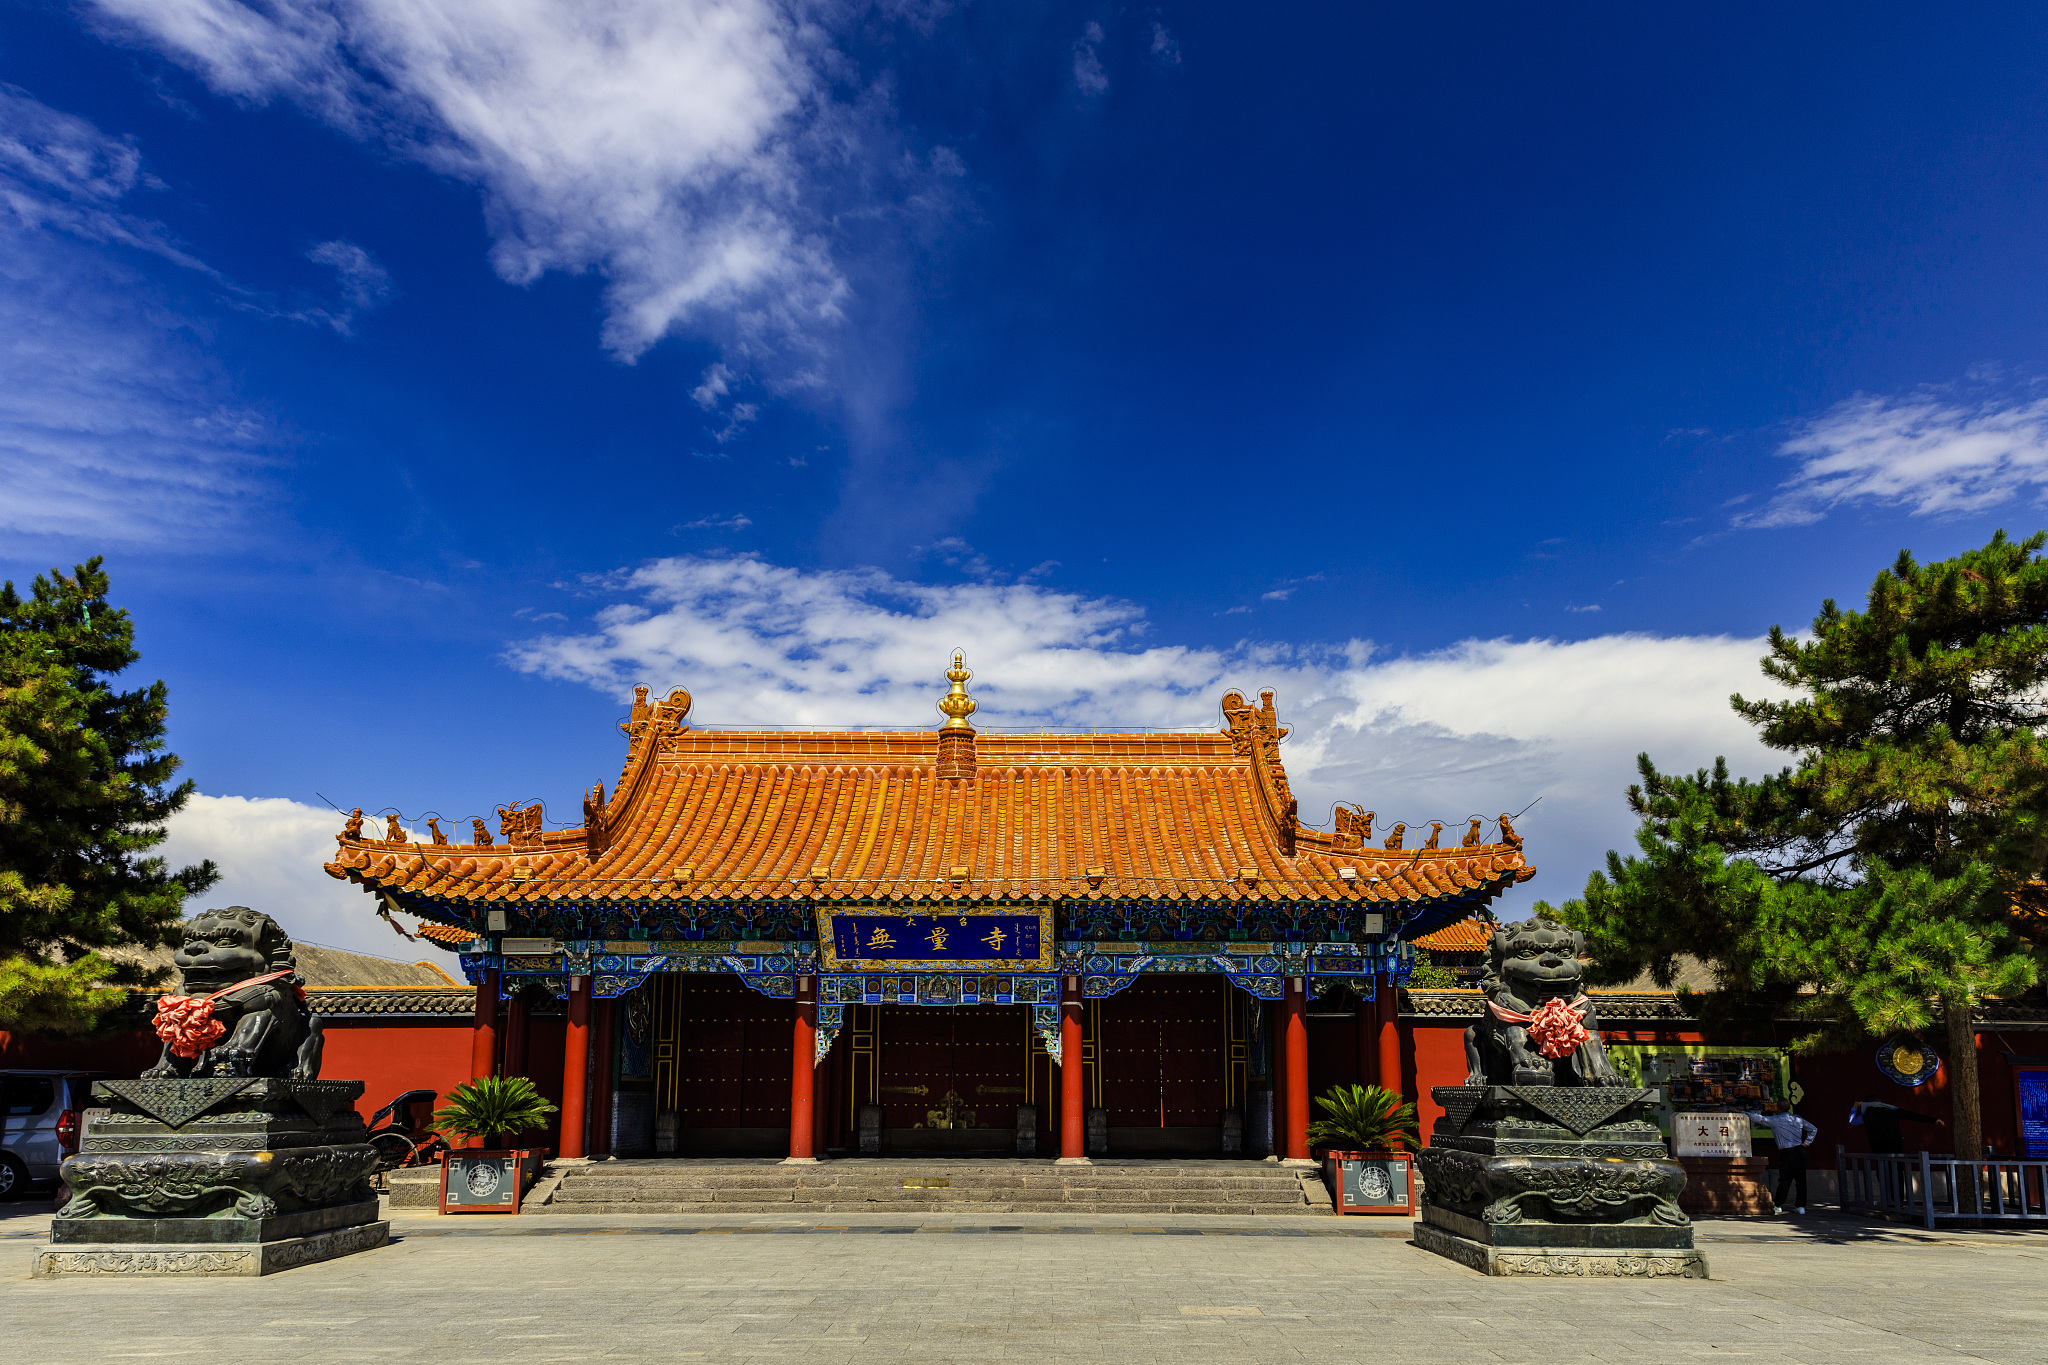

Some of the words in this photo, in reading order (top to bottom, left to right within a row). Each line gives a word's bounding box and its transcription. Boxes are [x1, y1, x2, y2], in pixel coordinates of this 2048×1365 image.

[906, 916, 968, 927] 大召
[866, 926, 1008, 952] 無量寺
[1697, 1125, 1729, 1137] 大召
